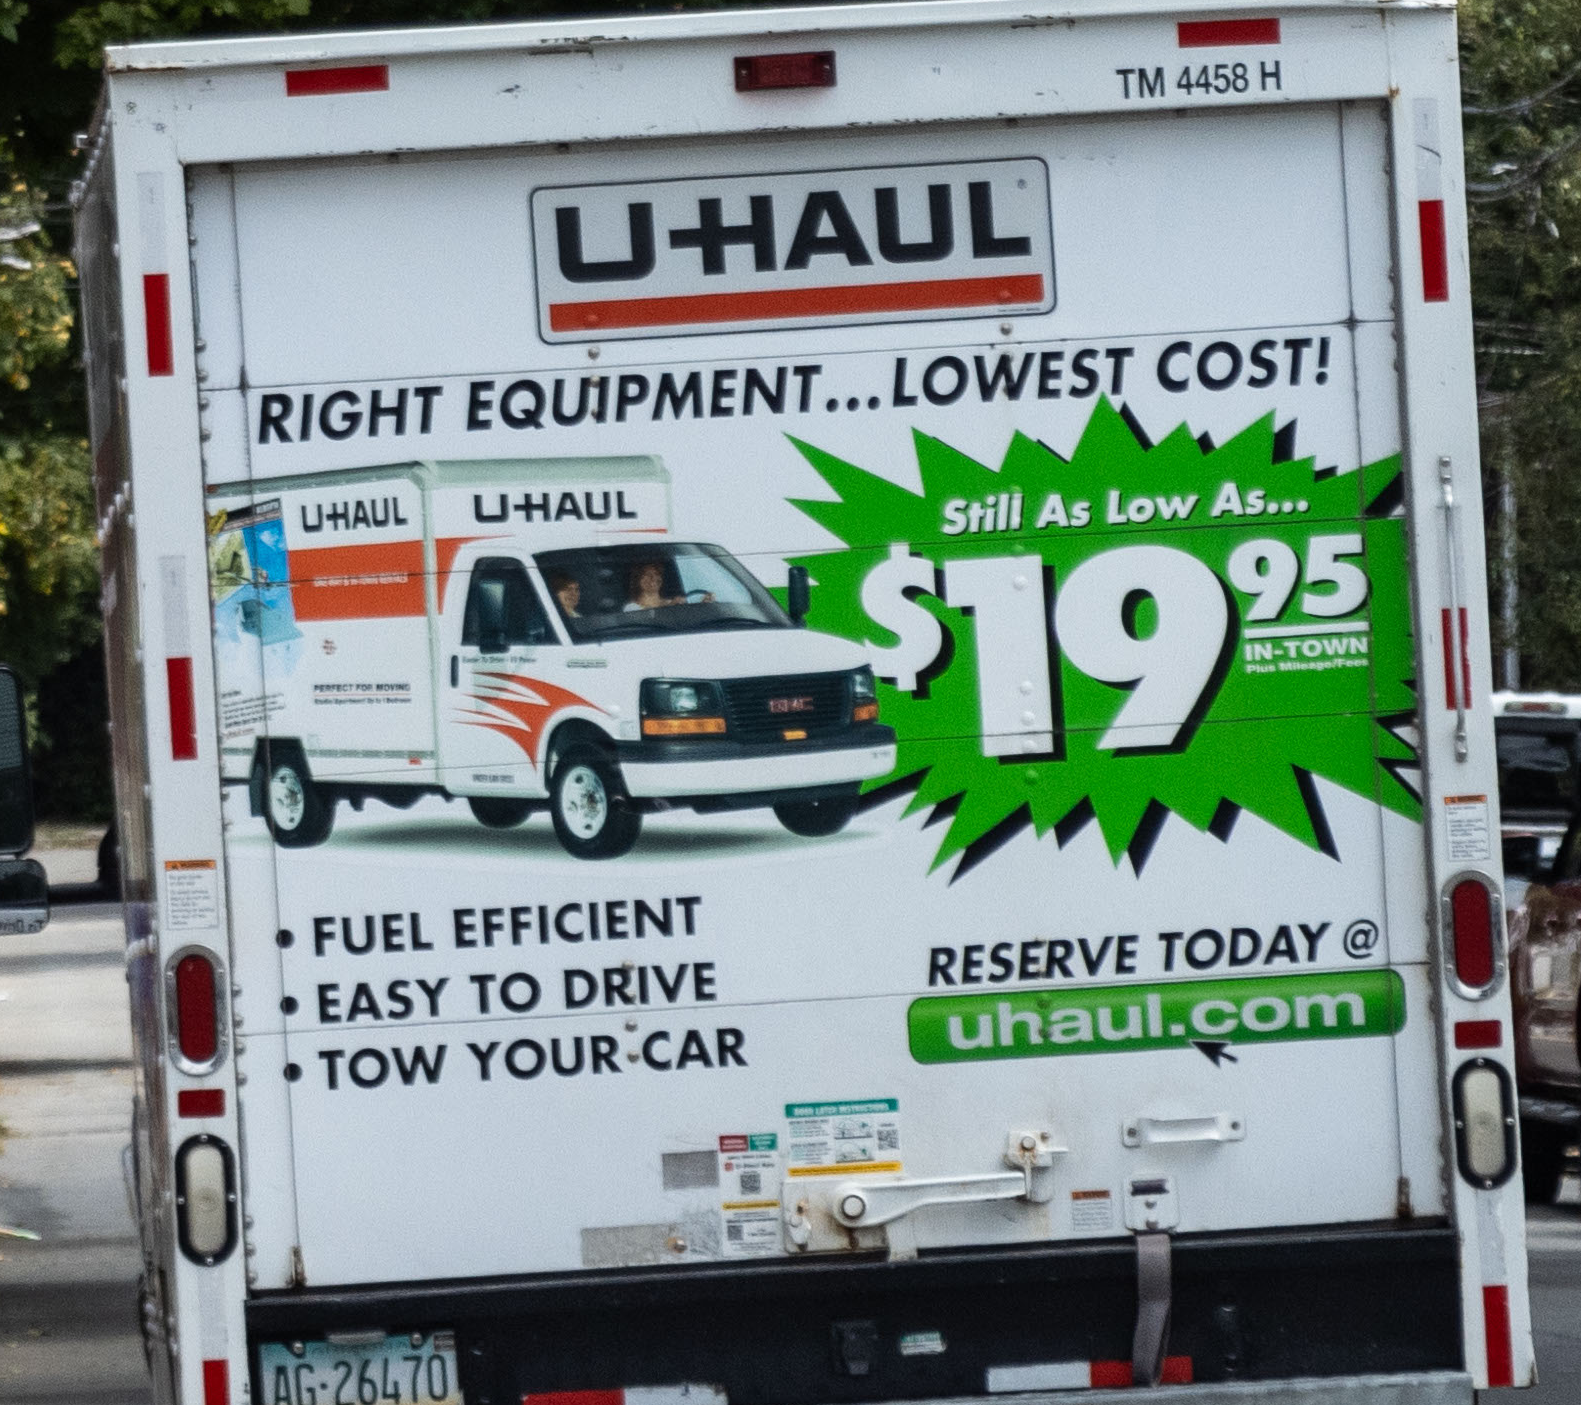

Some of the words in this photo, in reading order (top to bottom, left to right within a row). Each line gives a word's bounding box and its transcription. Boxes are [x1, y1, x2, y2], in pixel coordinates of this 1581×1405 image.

[1115, 66, 1166, 100] TM
[1176, 62, 1250, 96] 4458
[1259, 60, 1282, 92] H
[257, 384, 444, 445] RIGHT
[1156, 336, 1332, 394] COST!
[941, 492, 1022, 536] Still
[1035, 493, 1093, 529] As
[1106, 489, 1199, 526] Low
[1210, 481, 1310, 519] As...
[1244, 637, 1370, 662] IN-TOWN
[1246, 663, 1276, 673] Plus
[1278, 658, 1370, 672] Mileage/Fees
[376, 683, 411, 692] MOVING
[314, 912, 435, 957] FUEL
[452, 896, 704, 949] EFFICIENT
[928, 934, 1141, 986] RESERVE
[1157, 922, 1331, 972] TODAY
[318, 977, 450, 1025] EASY
[470, 972, 542, 1015] TO
[564, 962, 718, 1009] DRIVE
[948, 991, 1366, 1050] uhaul.com
[319, 1044, 448, 1091] TOW
[467, 1036, 622, 1082] YOUR
[640, 1027, 748, 1072] CAR
